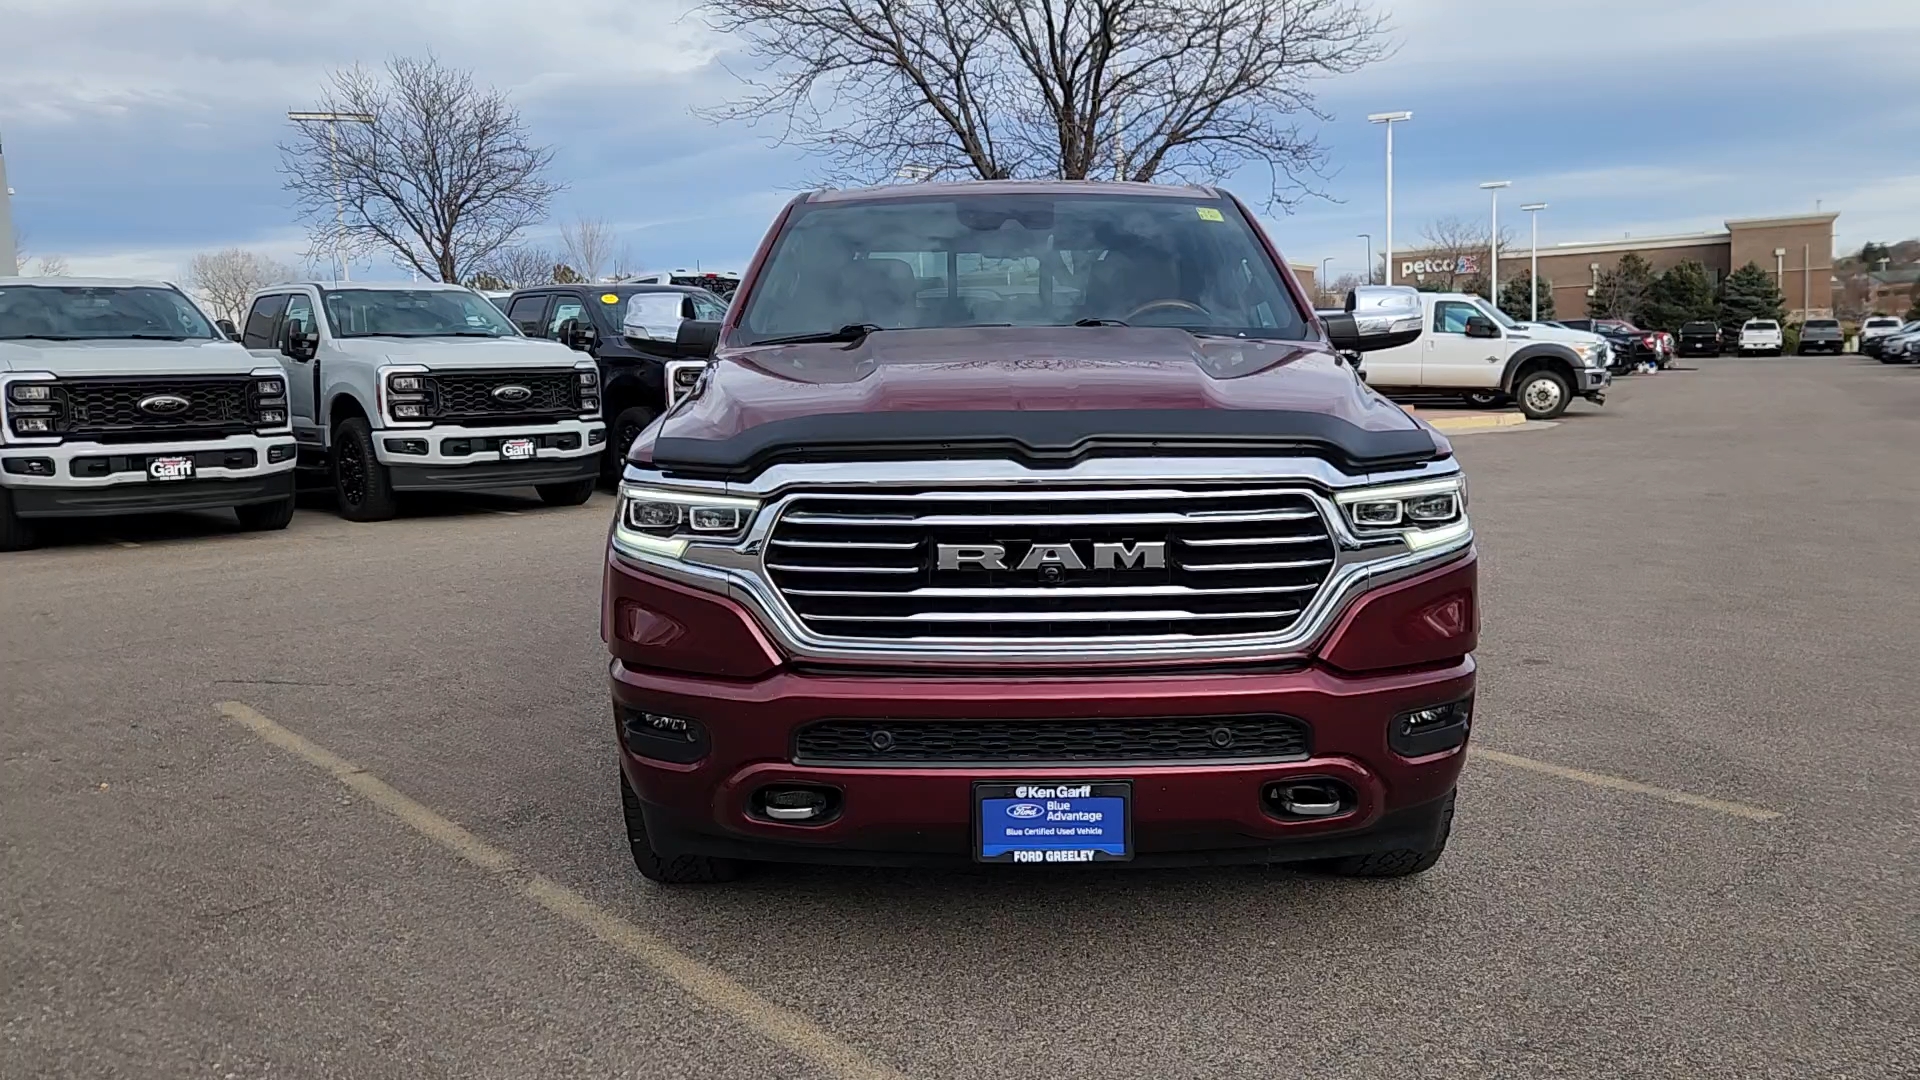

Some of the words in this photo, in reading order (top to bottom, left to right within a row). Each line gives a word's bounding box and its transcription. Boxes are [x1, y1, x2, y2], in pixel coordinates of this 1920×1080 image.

[1401, 258, 1456, 278] petco
[502, 441, 534, 457] Garff
[150, 460, 192, 477] Garff
[937, 542, 1166, 570] RAM
[1028, 786, 1055, 798] Ken
[1056, 785, 1091, 798] Garff
[1013, 805, 1038, 816] Ford
[1046, 801, 1071, 810] Blue
[1046, 811, 1103, 823] Advantage
[1006, 828, 1023, 836] Blue
[1024, 827, 1055, 836] Certified
[1056, 827, 1075, 836] Used
[1076, 827, 1103, 836] Vehicle
[1013, 850, 1043, 863] FORD
[1045, 849, 1095, 862] GREELEY
